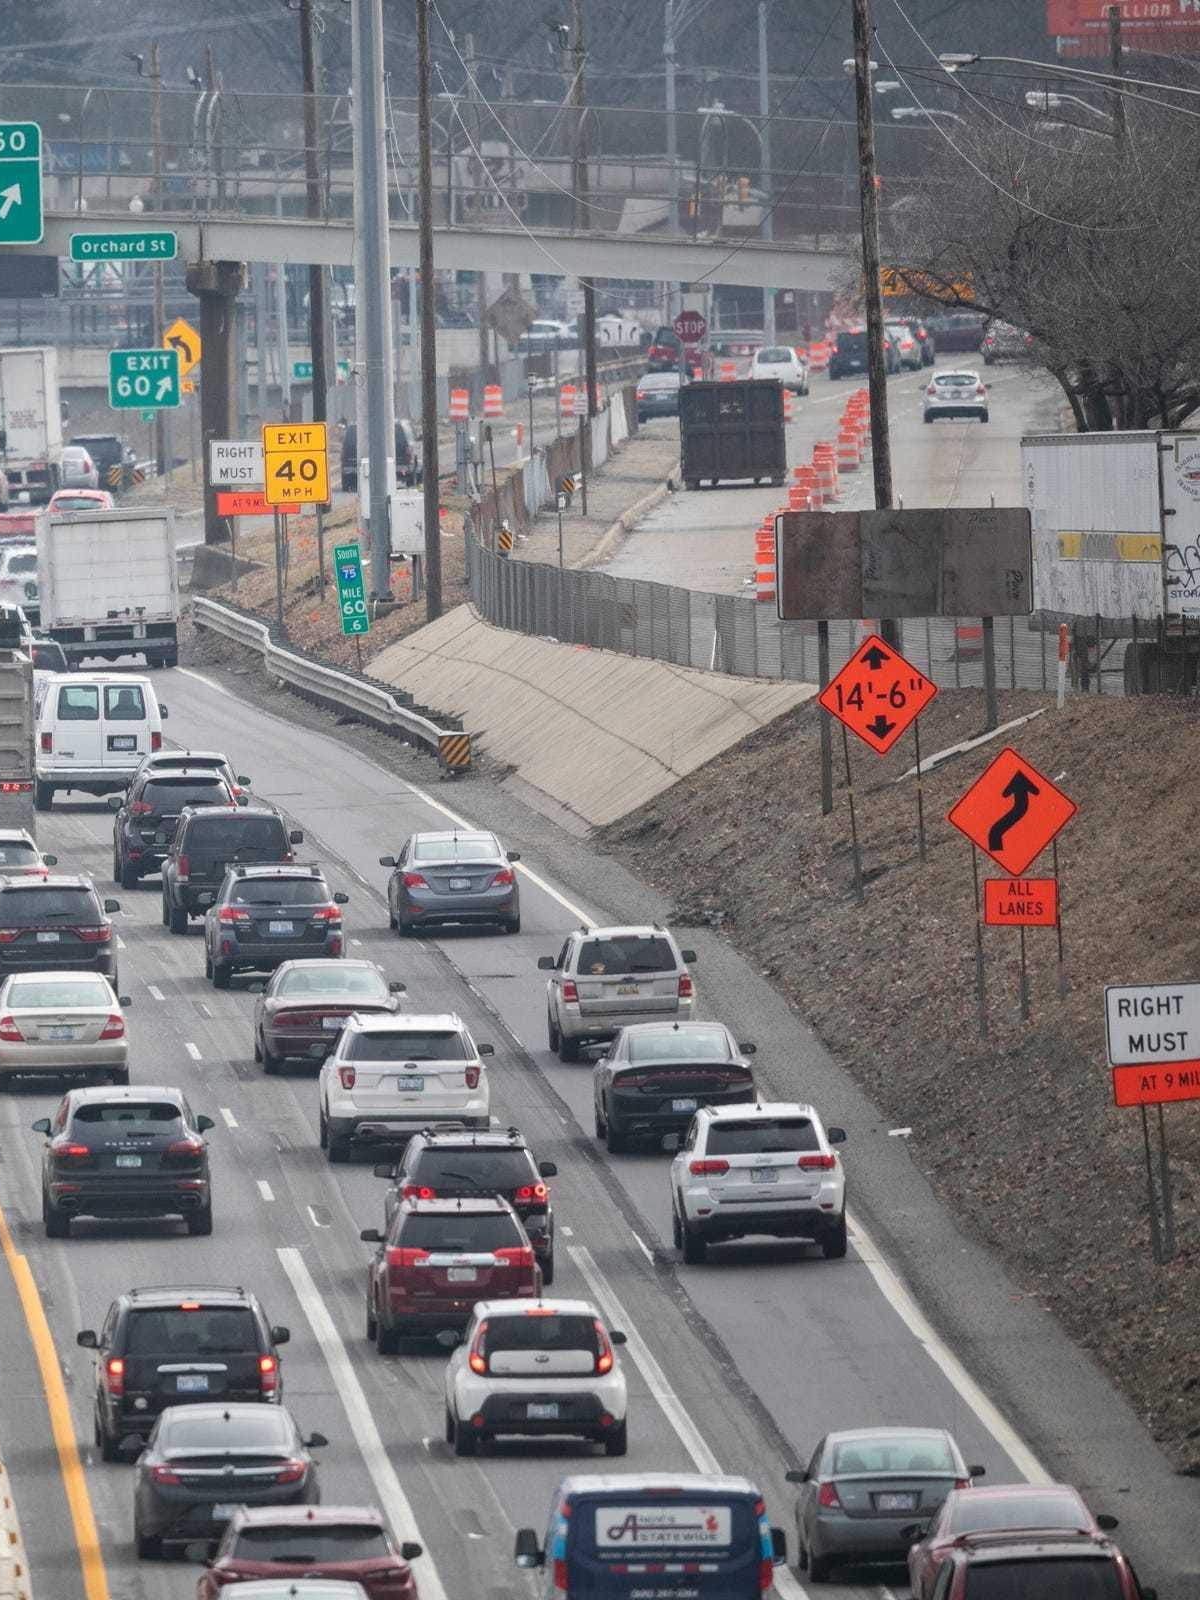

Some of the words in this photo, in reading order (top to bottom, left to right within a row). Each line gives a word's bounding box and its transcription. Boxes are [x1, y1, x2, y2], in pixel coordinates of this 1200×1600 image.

[1100, 4, 1170, 17] MLLION
[81, 239, 145, 254] Orchard
[150, 239, 167, 252] St
[676, 321, 705, 334] STOP
[126, 356, 171, 371] EXIT
[117, 376, 150, 396] 60
[277, 432, 312, 444] EXIT
[217, 447, 254, 458] RIGHT
[220, 467, 254, 478] MUST
[275, 459, 318, 481] 40
[281, 487, 313, 497] MPH
[232, 499, 242, 507] AT
[337, 549, 357, 560] SOUTH
[342, 568, 357, 579] 75
[341, 586, 362, 598] MILE
[343, 600, 365, 615] 60
[350, 620, 362, 631] .6
[835, 678, 923, 713] 14'-6"
[1008, 881, 1033, 896] ALL
[999, 901, 1044, 916] LANES
[1118, 995, 1184, 1018] RIGHT
[1128, 1032, 1188, 1053] MUST
[1141, 1075, 1157, 1091] AT
[1165, 1073, 1173, 1088] 9
